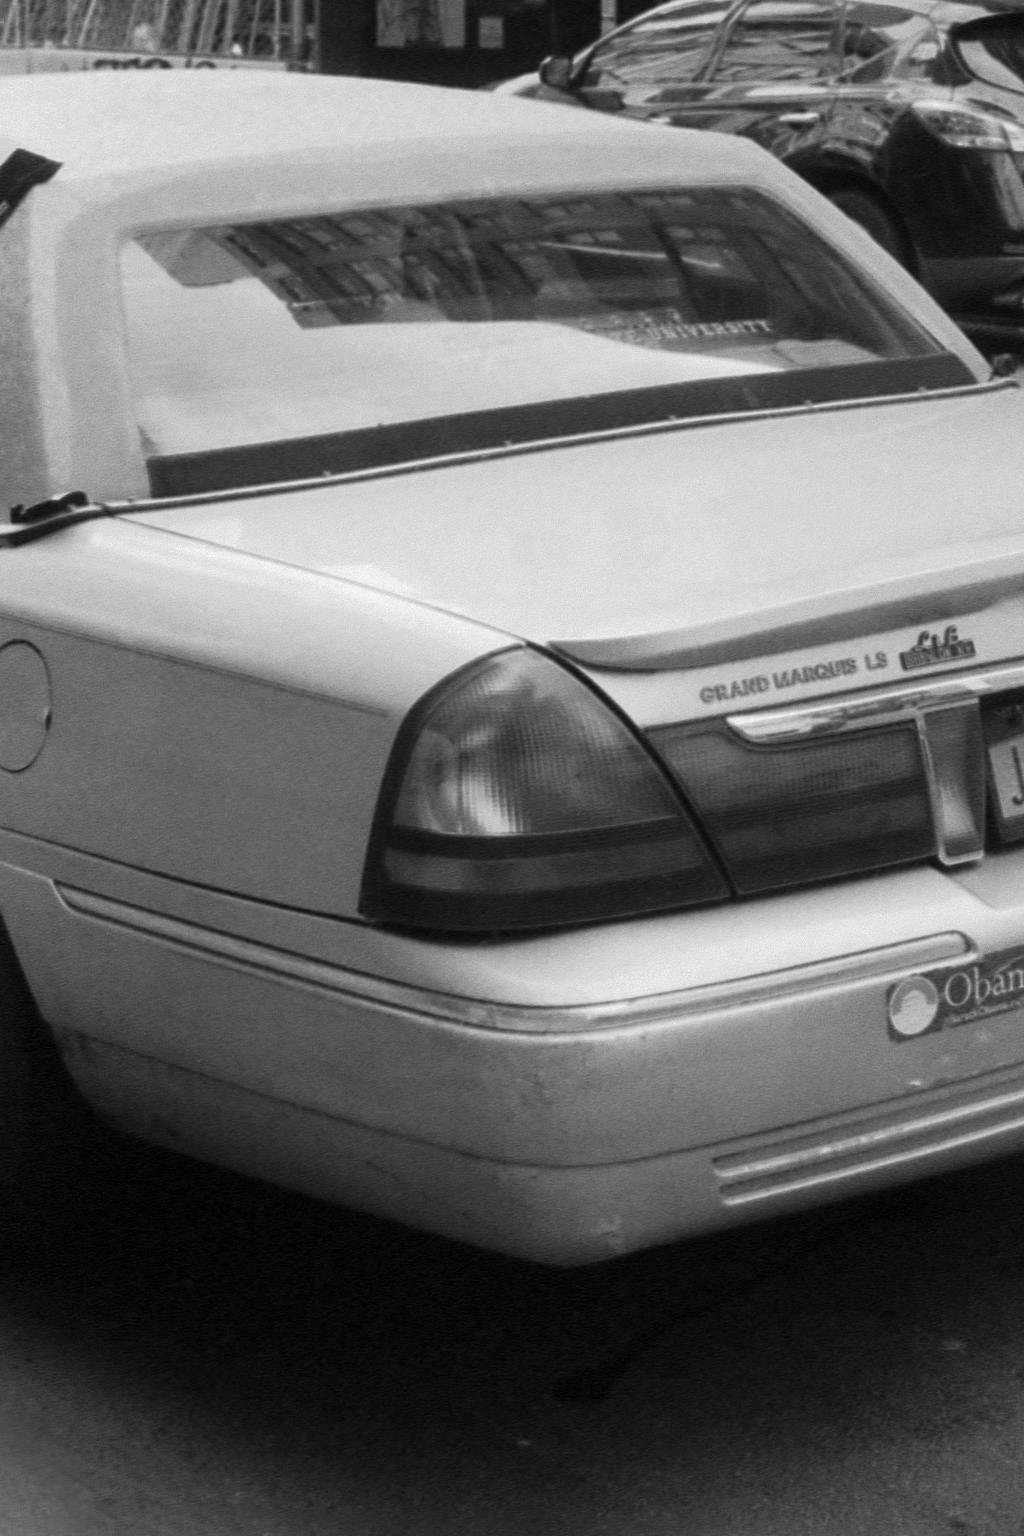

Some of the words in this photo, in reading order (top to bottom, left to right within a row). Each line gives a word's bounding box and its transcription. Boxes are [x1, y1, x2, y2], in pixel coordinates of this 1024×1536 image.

[699, 676, 770, 705] GRAND
[772, 657, 858, 690] MARQUIS
[864, 650, 889, 671] LS
